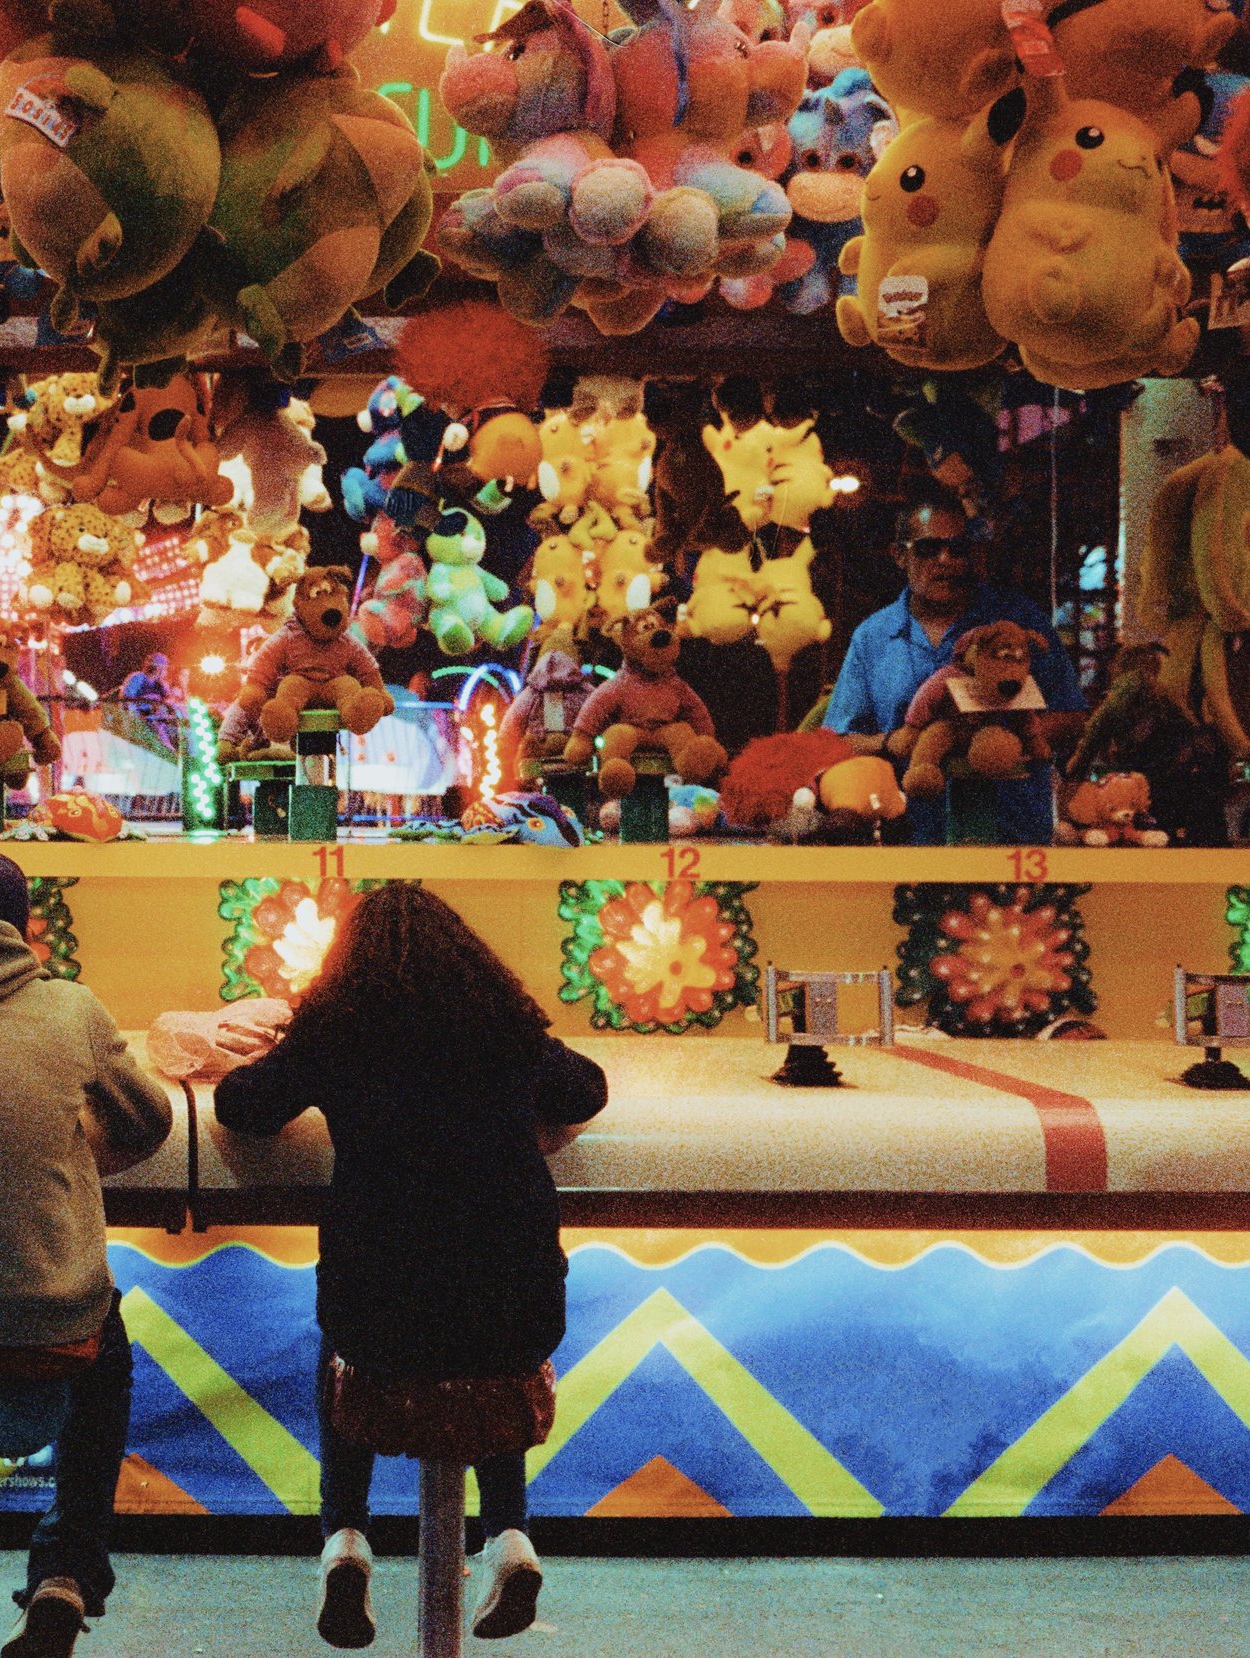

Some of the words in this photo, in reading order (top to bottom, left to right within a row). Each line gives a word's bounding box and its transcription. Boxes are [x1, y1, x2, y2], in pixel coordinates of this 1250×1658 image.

[312, 845, 344, 877] 11
[660, 847, 701, 878] 12
[1006, 849, 1048, 881] 13
